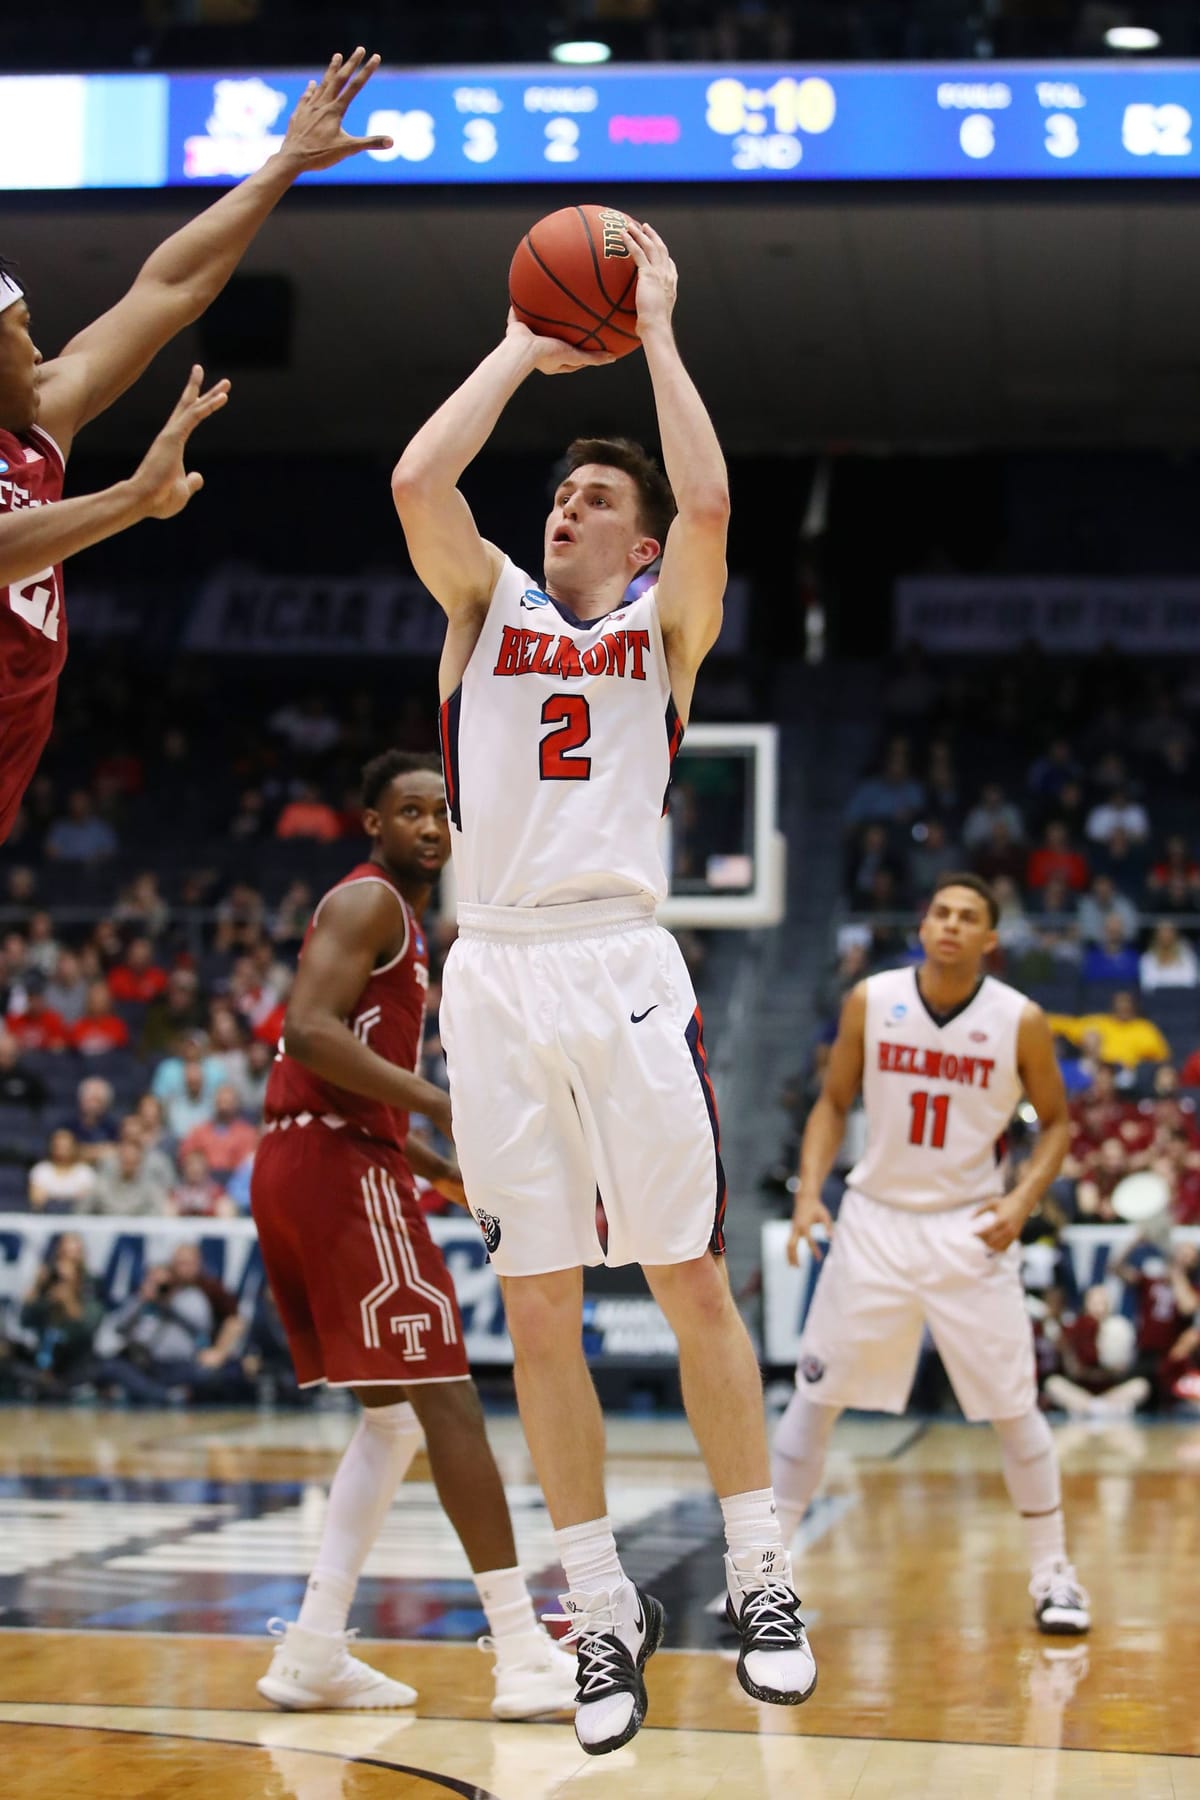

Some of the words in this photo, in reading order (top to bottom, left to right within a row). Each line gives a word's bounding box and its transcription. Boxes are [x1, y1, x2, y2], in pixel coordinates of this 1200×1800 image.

[706, 78, 836, 135] 8:10
[462, 117, 497, 163] 3
[544, 117, 580, 163] 2
[1044, 113, 1079, 159] 3
[493, 625, 651, 681] BELMONT
[539, 693, 592, 781] 2
[877, 1041, 995, 1090] BELMONT
[910, 1091, 951, 1150] 11
